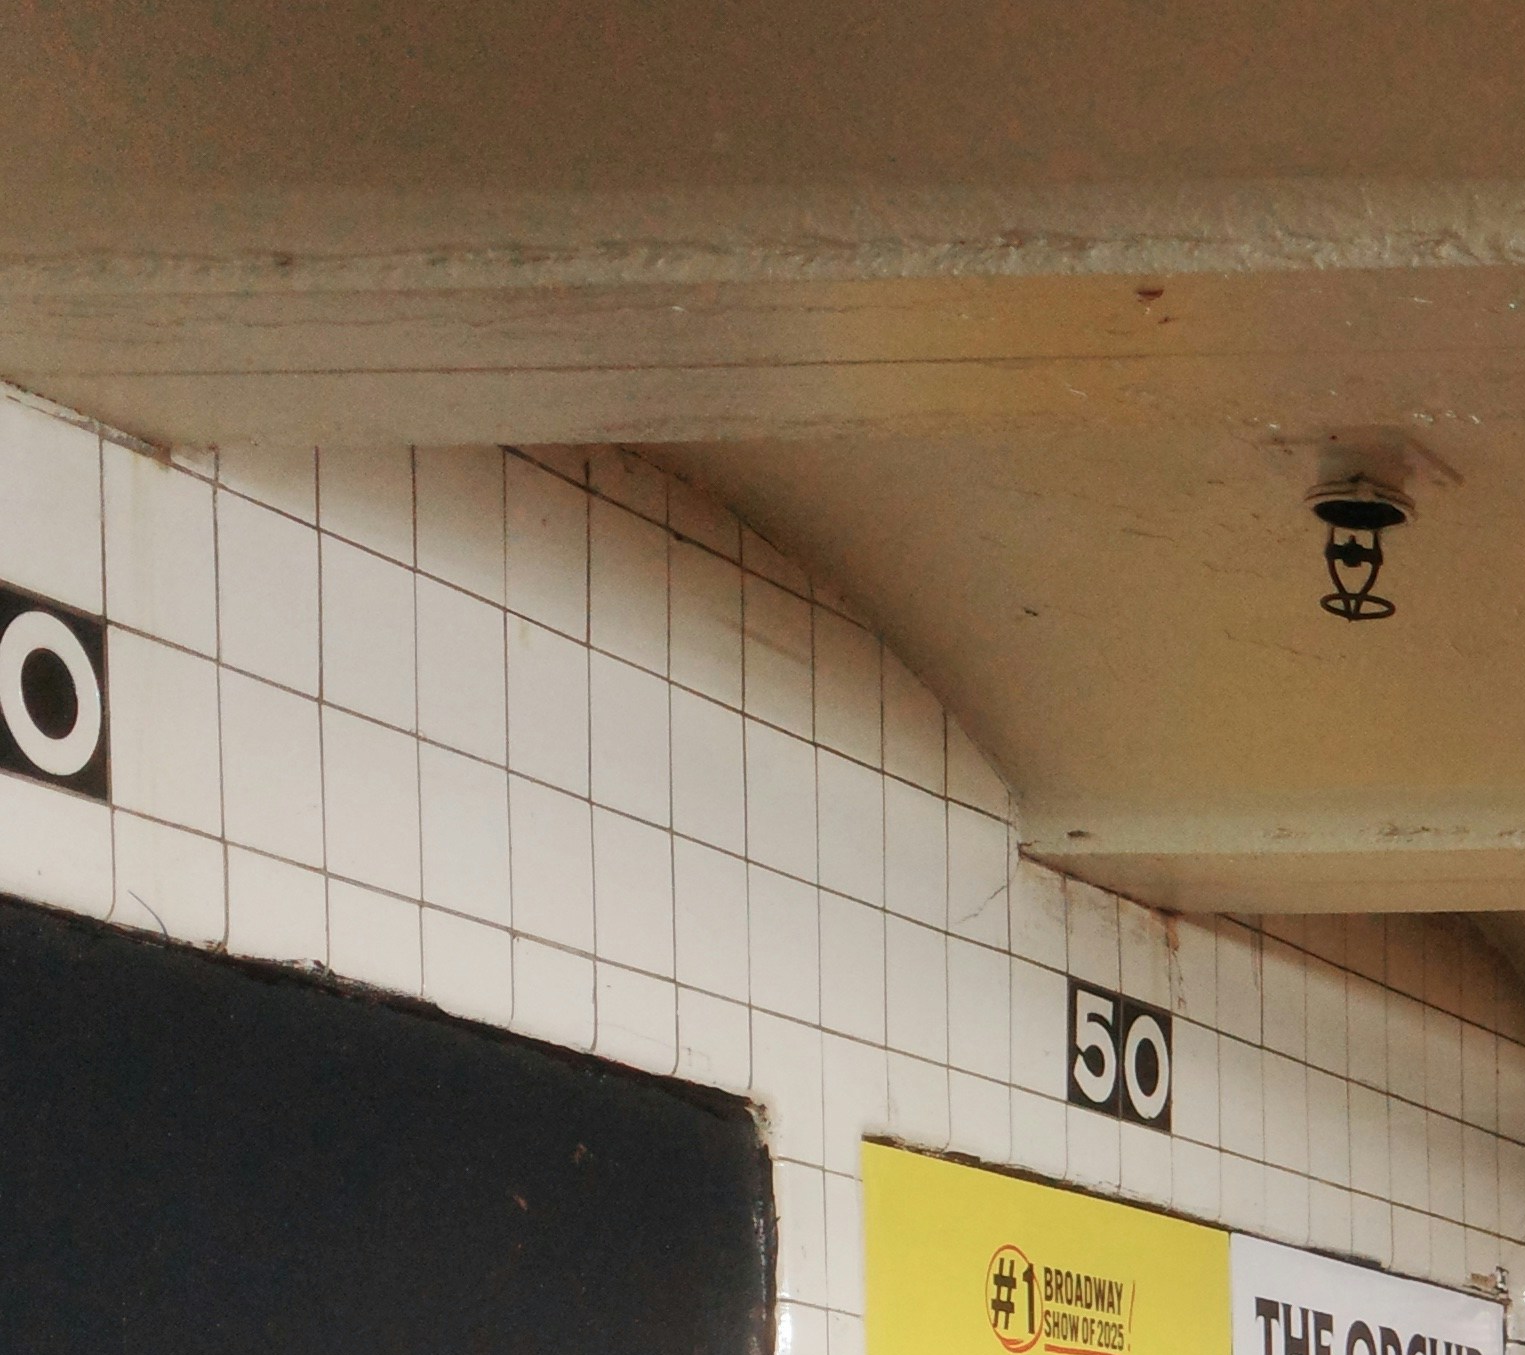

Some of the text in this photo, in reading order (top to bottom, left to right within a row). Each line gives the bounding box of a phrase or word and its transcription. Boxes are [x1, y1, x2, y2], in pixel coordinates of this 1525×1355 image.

[1074, 989, 1169, 1120] 50
[991, 1258, 1035, 1334] #1
[1044, 1267, 1123, 1316] BROADWAY
[1044, 1310, 1124, 1351] SHOW OF 2025
